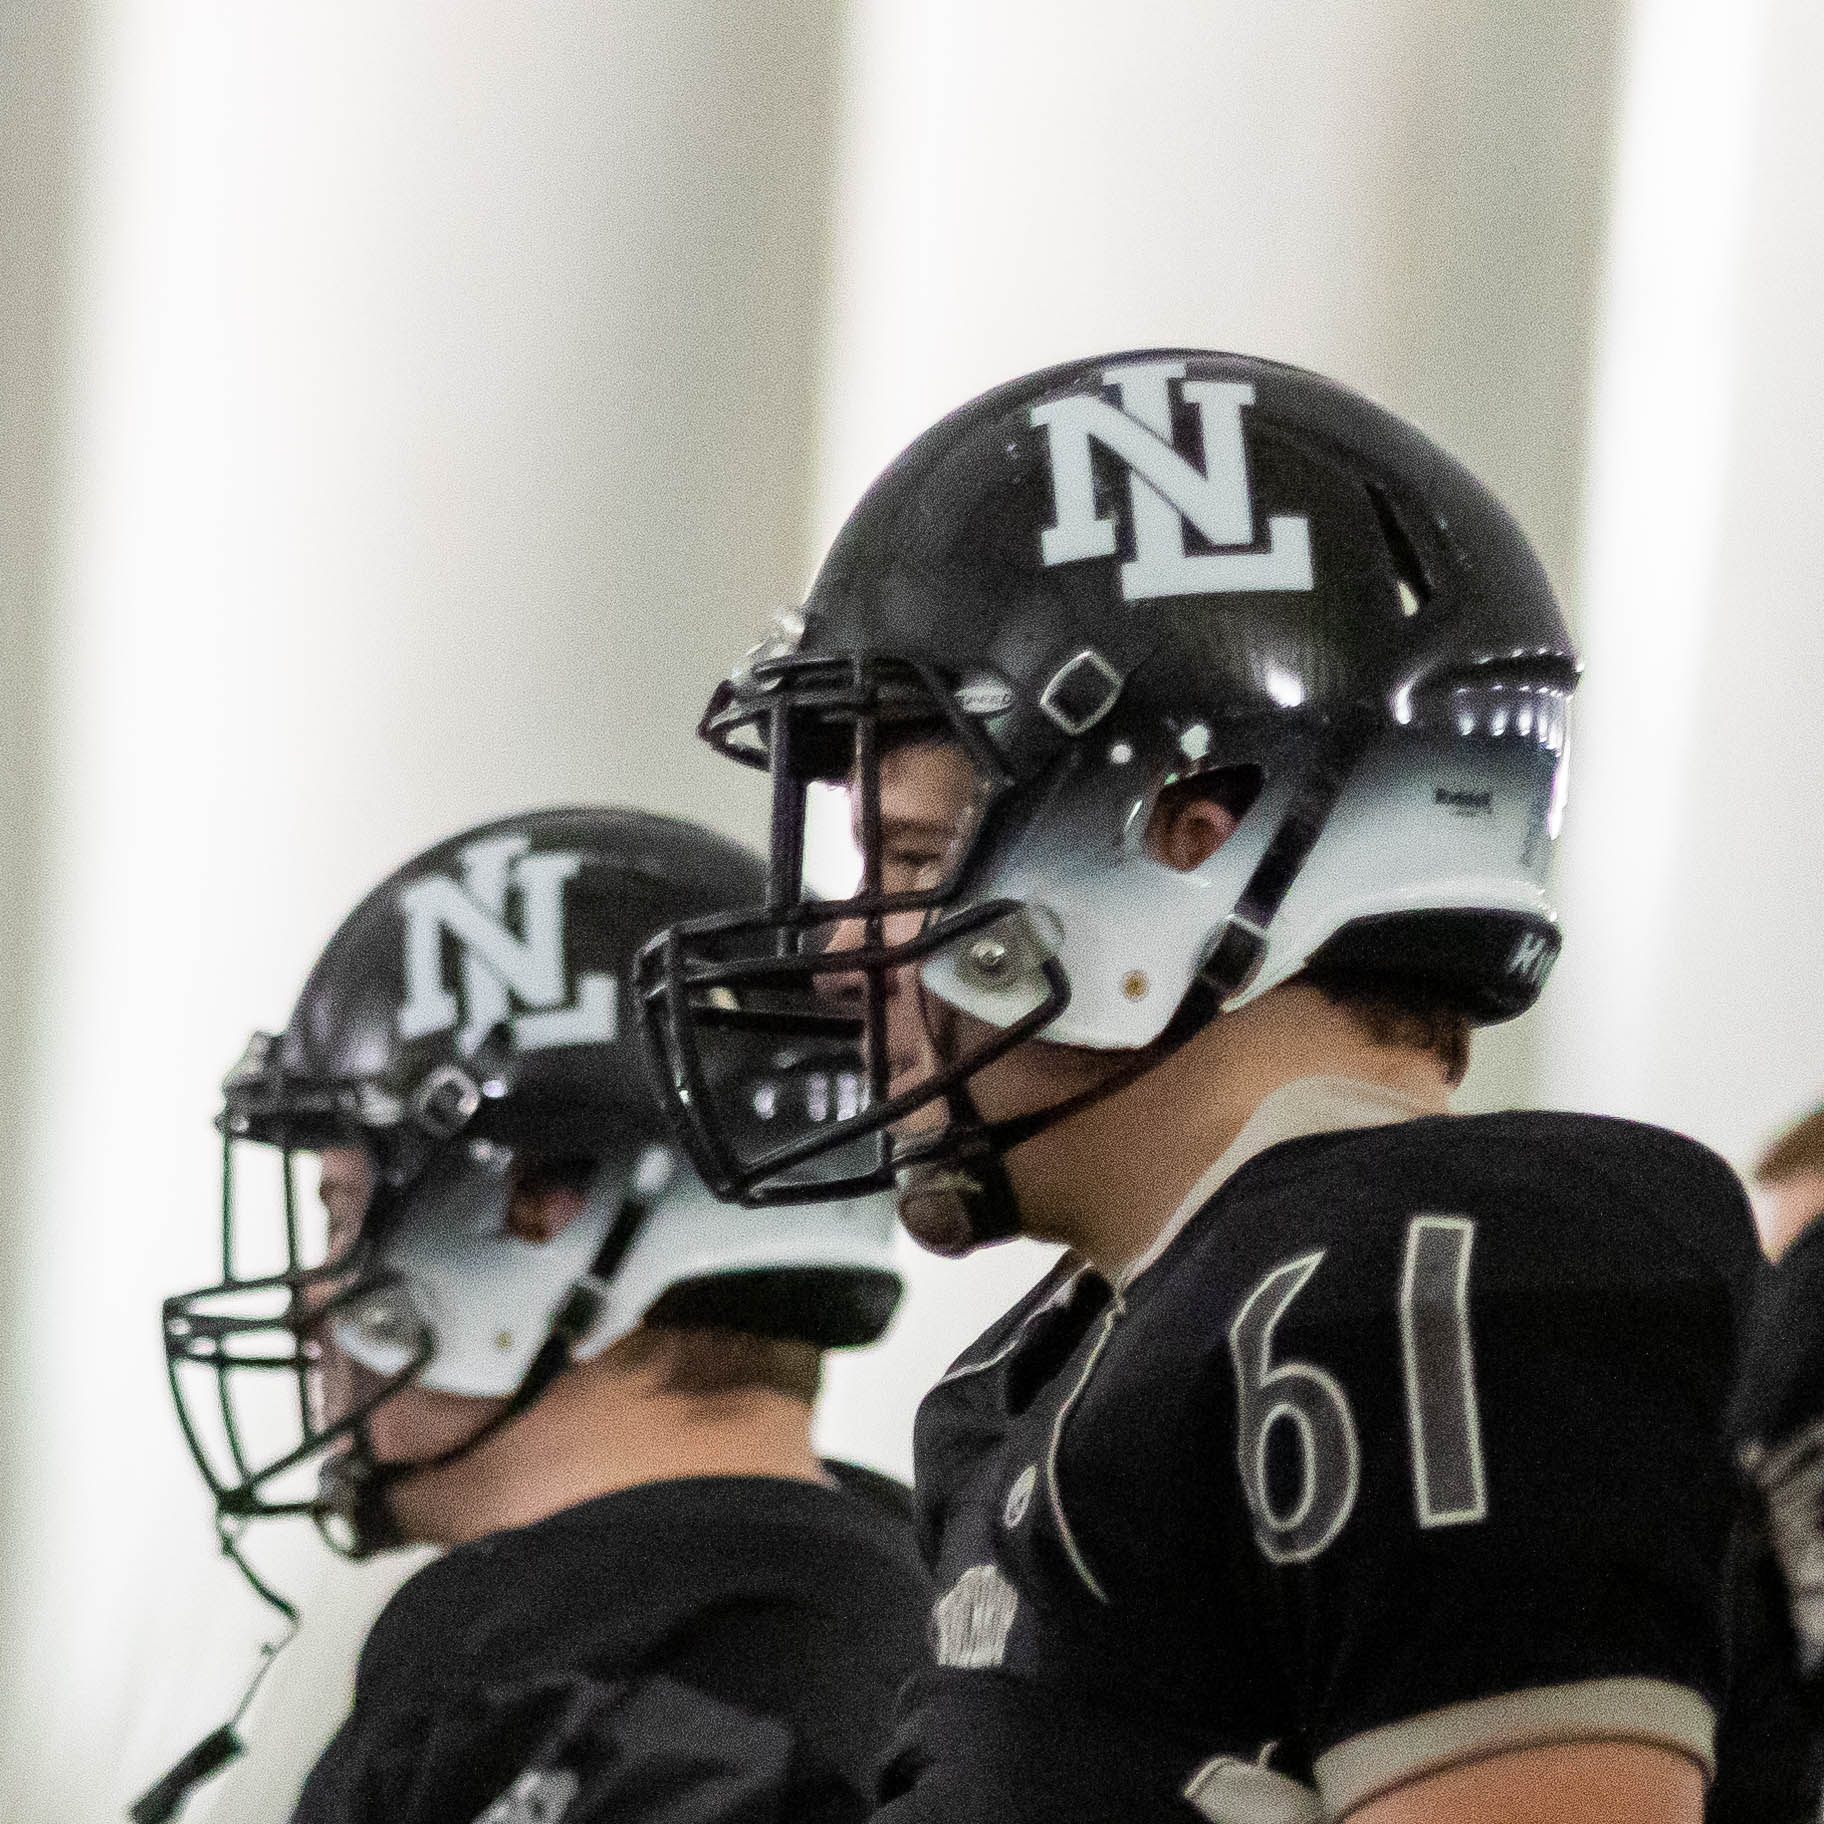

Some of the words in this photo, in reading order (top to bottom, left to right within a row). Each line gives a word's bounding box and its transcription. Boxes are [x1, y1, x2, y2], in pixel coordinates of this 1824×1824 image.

[1029, 362, 1314, 600] NL
[399, 835, 617, 1055] NL
[1229, 1214, 1488, 1566] 61
